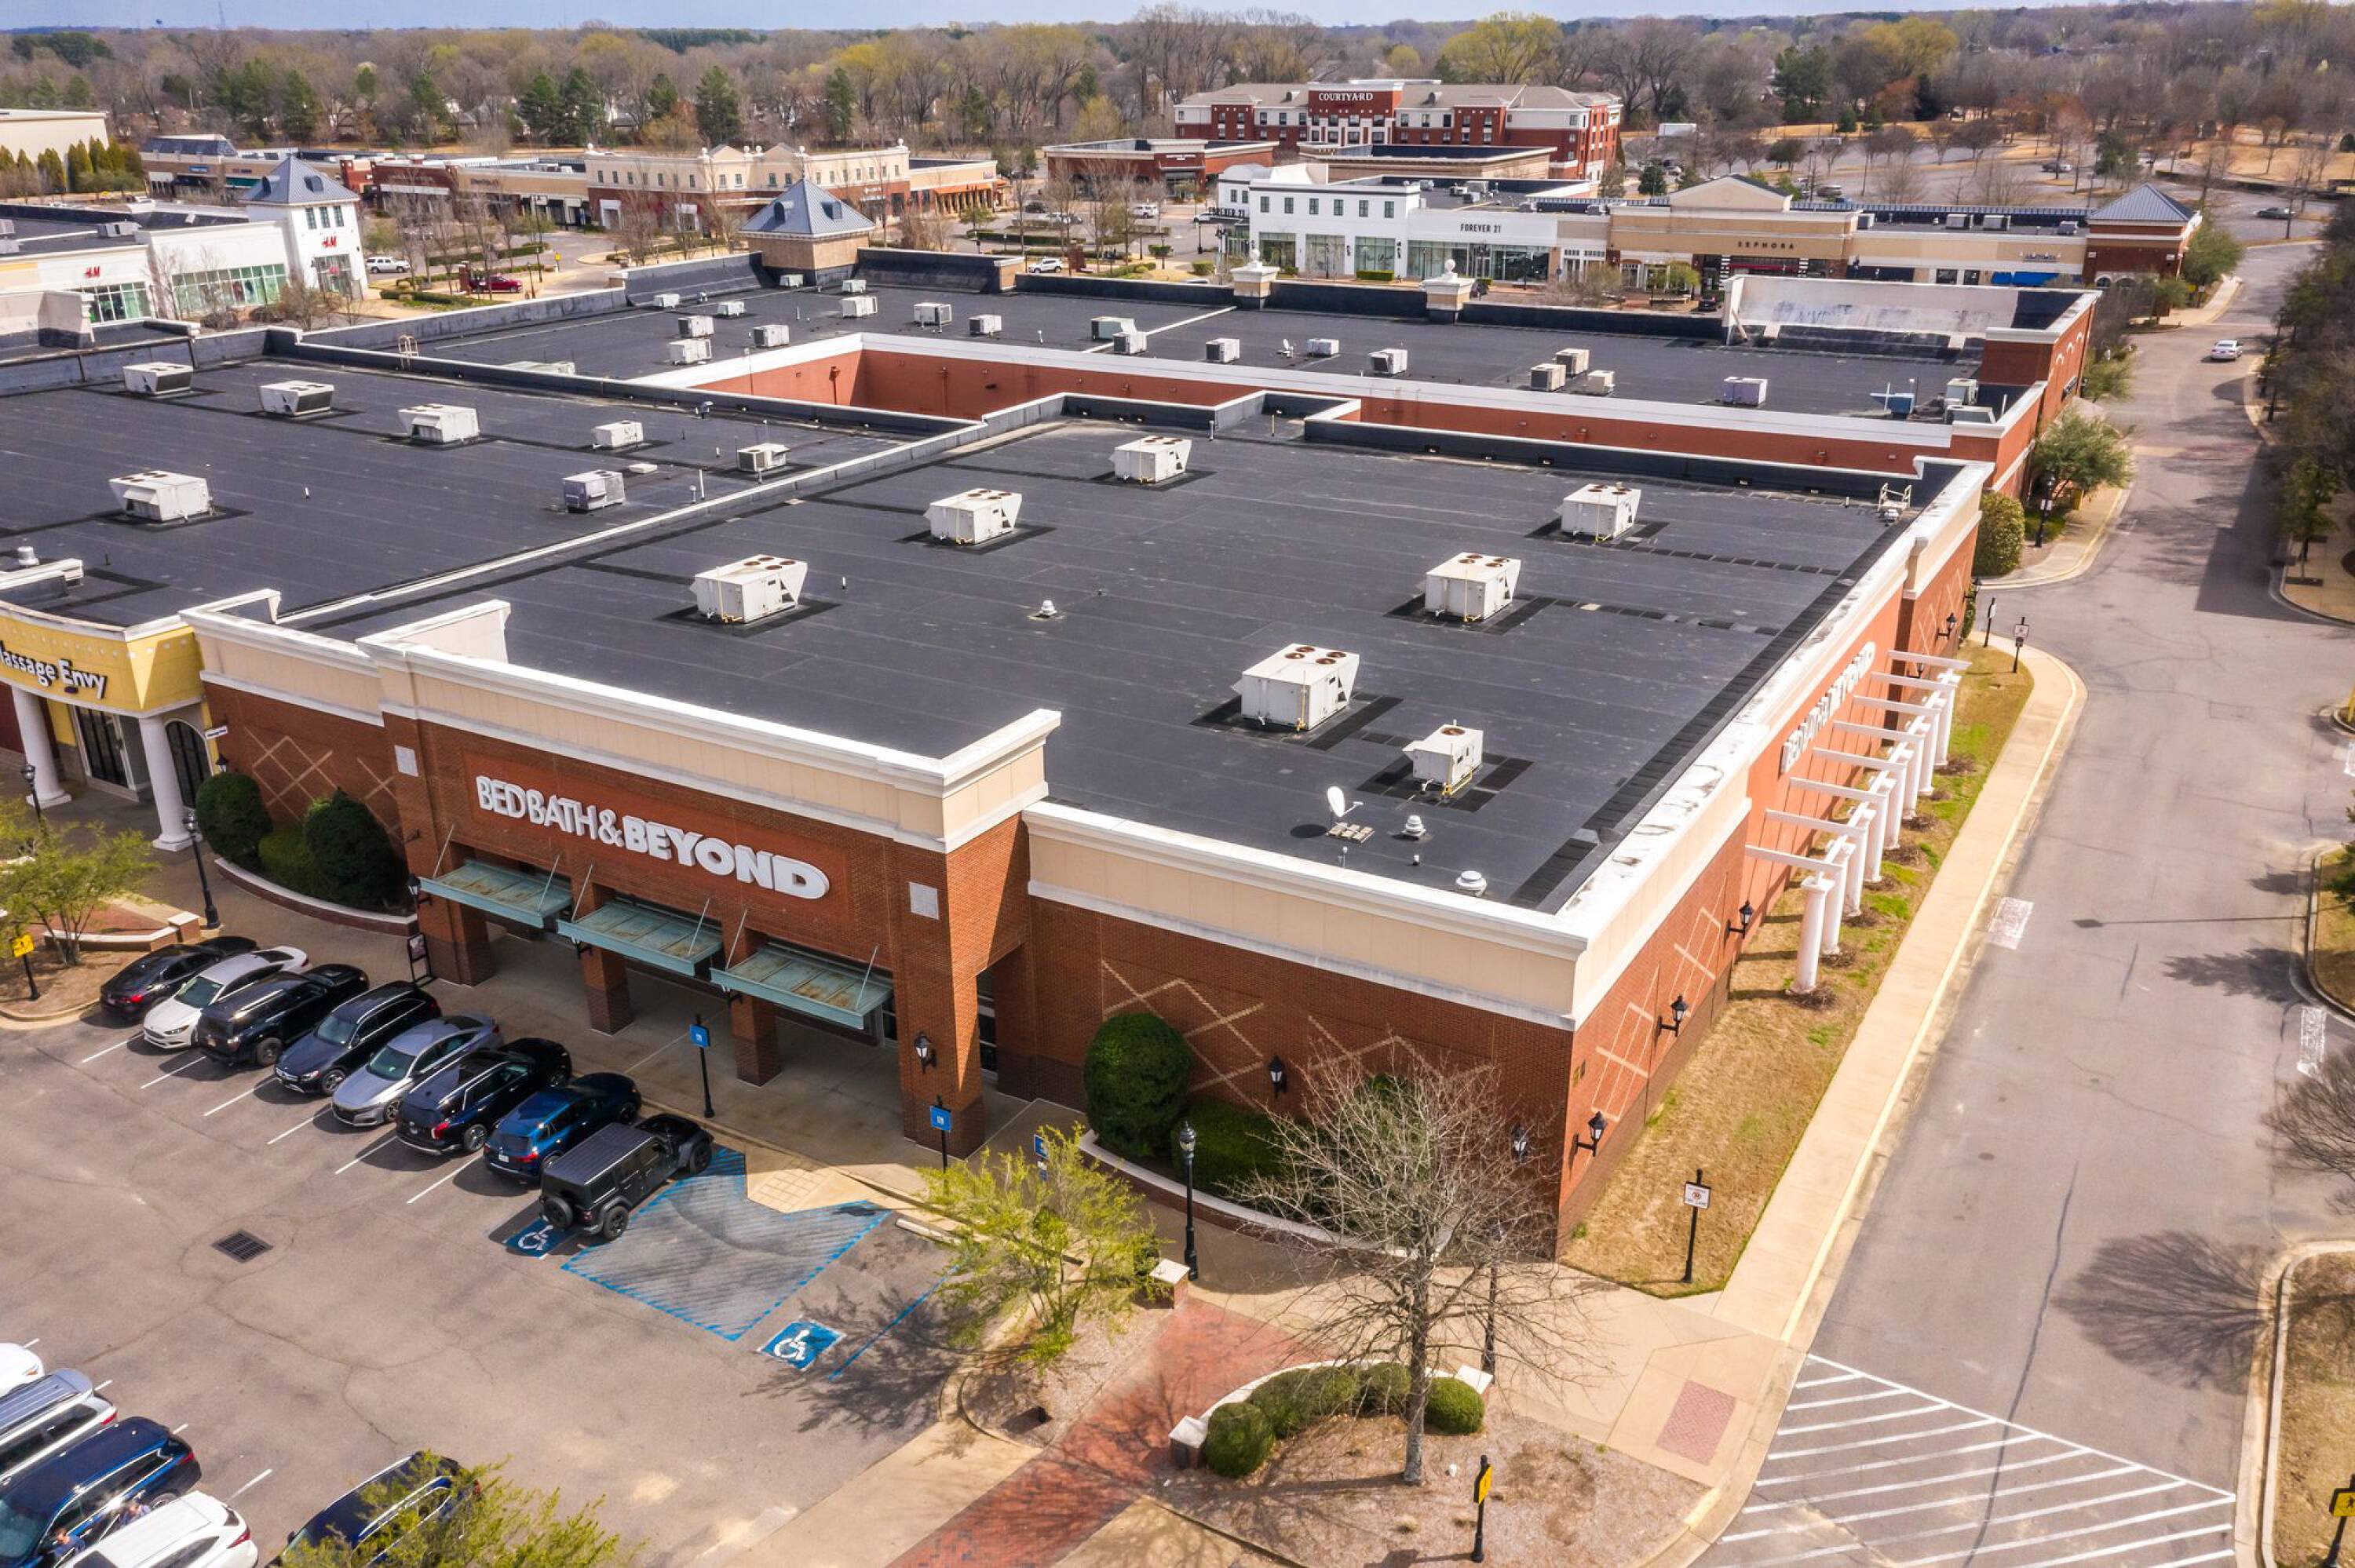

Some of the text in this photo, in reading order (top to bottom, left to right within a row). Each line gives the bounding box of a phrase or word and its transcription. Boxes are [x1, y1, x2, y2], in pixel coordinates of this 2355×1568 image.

[1318, 93, 1373, 101] COURTYARD
[1460, 223, 1501, 233] FOREVER 21
[1738, 240, 1794, 250] SEPHORA
[58, 658, 108, 699] Envy
[476, 775, 830, 899] BED BATH & BEYOND
